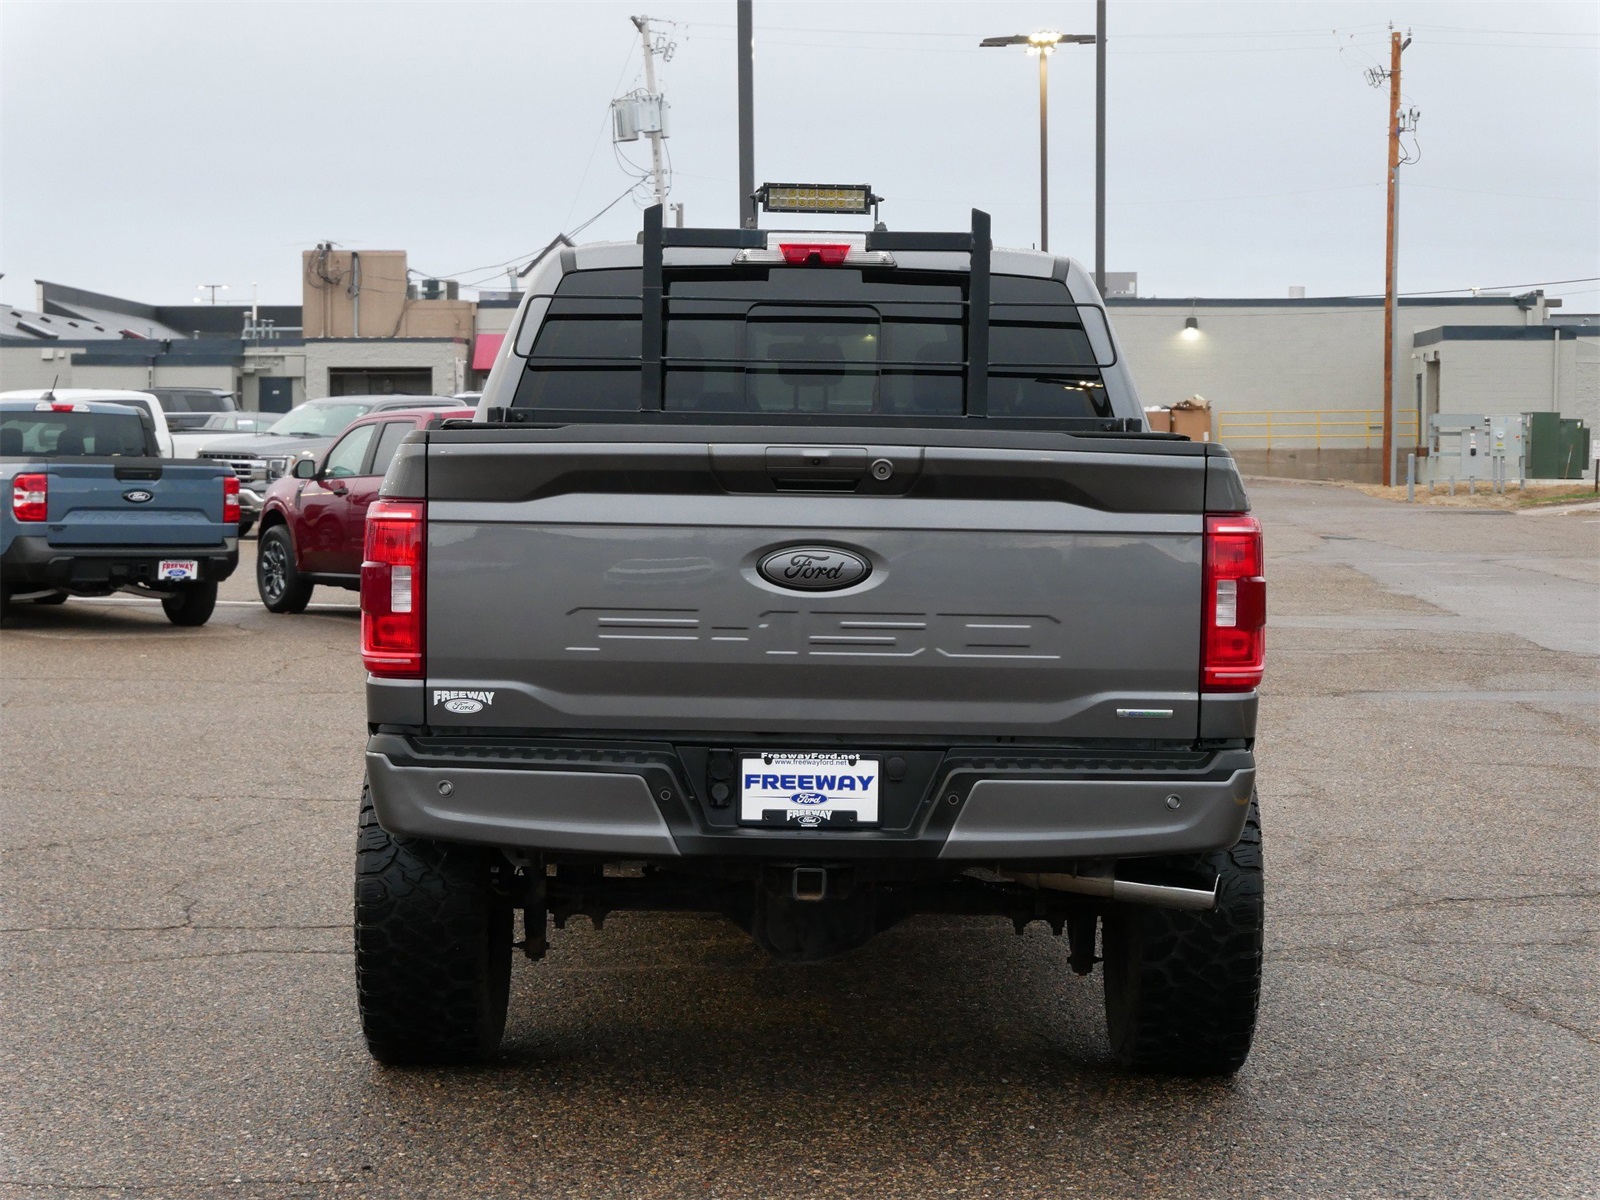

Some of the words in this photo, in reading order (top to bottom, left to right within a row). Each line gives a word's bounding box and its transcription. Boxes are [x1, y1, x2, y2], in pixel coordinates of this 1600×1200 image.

[162, 563, 194, 572] FREEWAY
[784, 554, 845, 579] Ford
[433, 690, 495, 706] FREEWAY
[452, 701, 476, 711] Ford
[760, 752, 860, 760] FreewayFord.net
[744, 773, 875, 791] FREEWAY
[796, 793, 822, 804] Ford
[786, 809, 833, 821] FREEWAY
